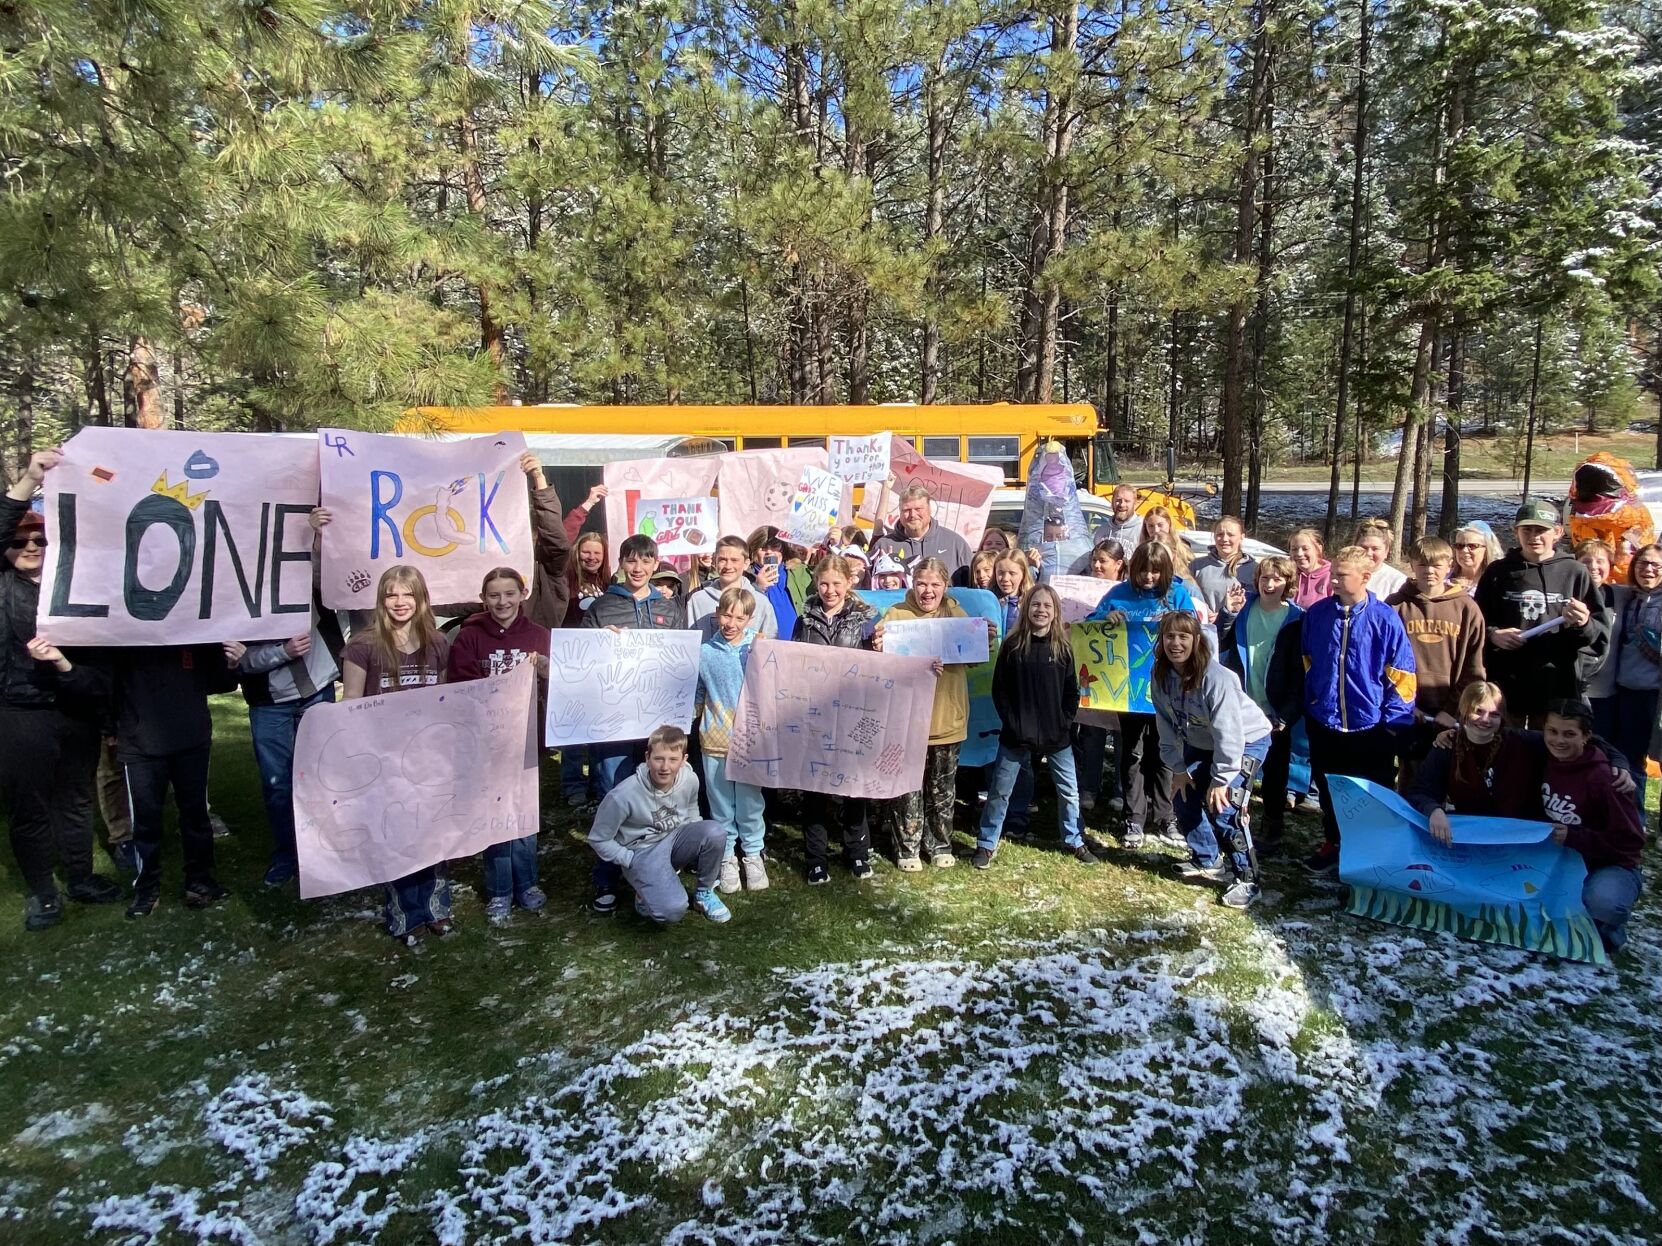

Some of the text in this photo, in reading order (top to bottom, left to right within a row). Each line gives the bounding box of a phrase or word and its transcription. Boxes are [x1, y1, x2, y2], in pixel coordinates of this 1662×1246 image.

[662, 503, 702, 515] THANK
[49, 492, 317, 621] LONE
[1407, 619, 1460, 638] ONTANA
[762, 650, 779, 670] A
[1541, 782, 1582, 825] Griz
